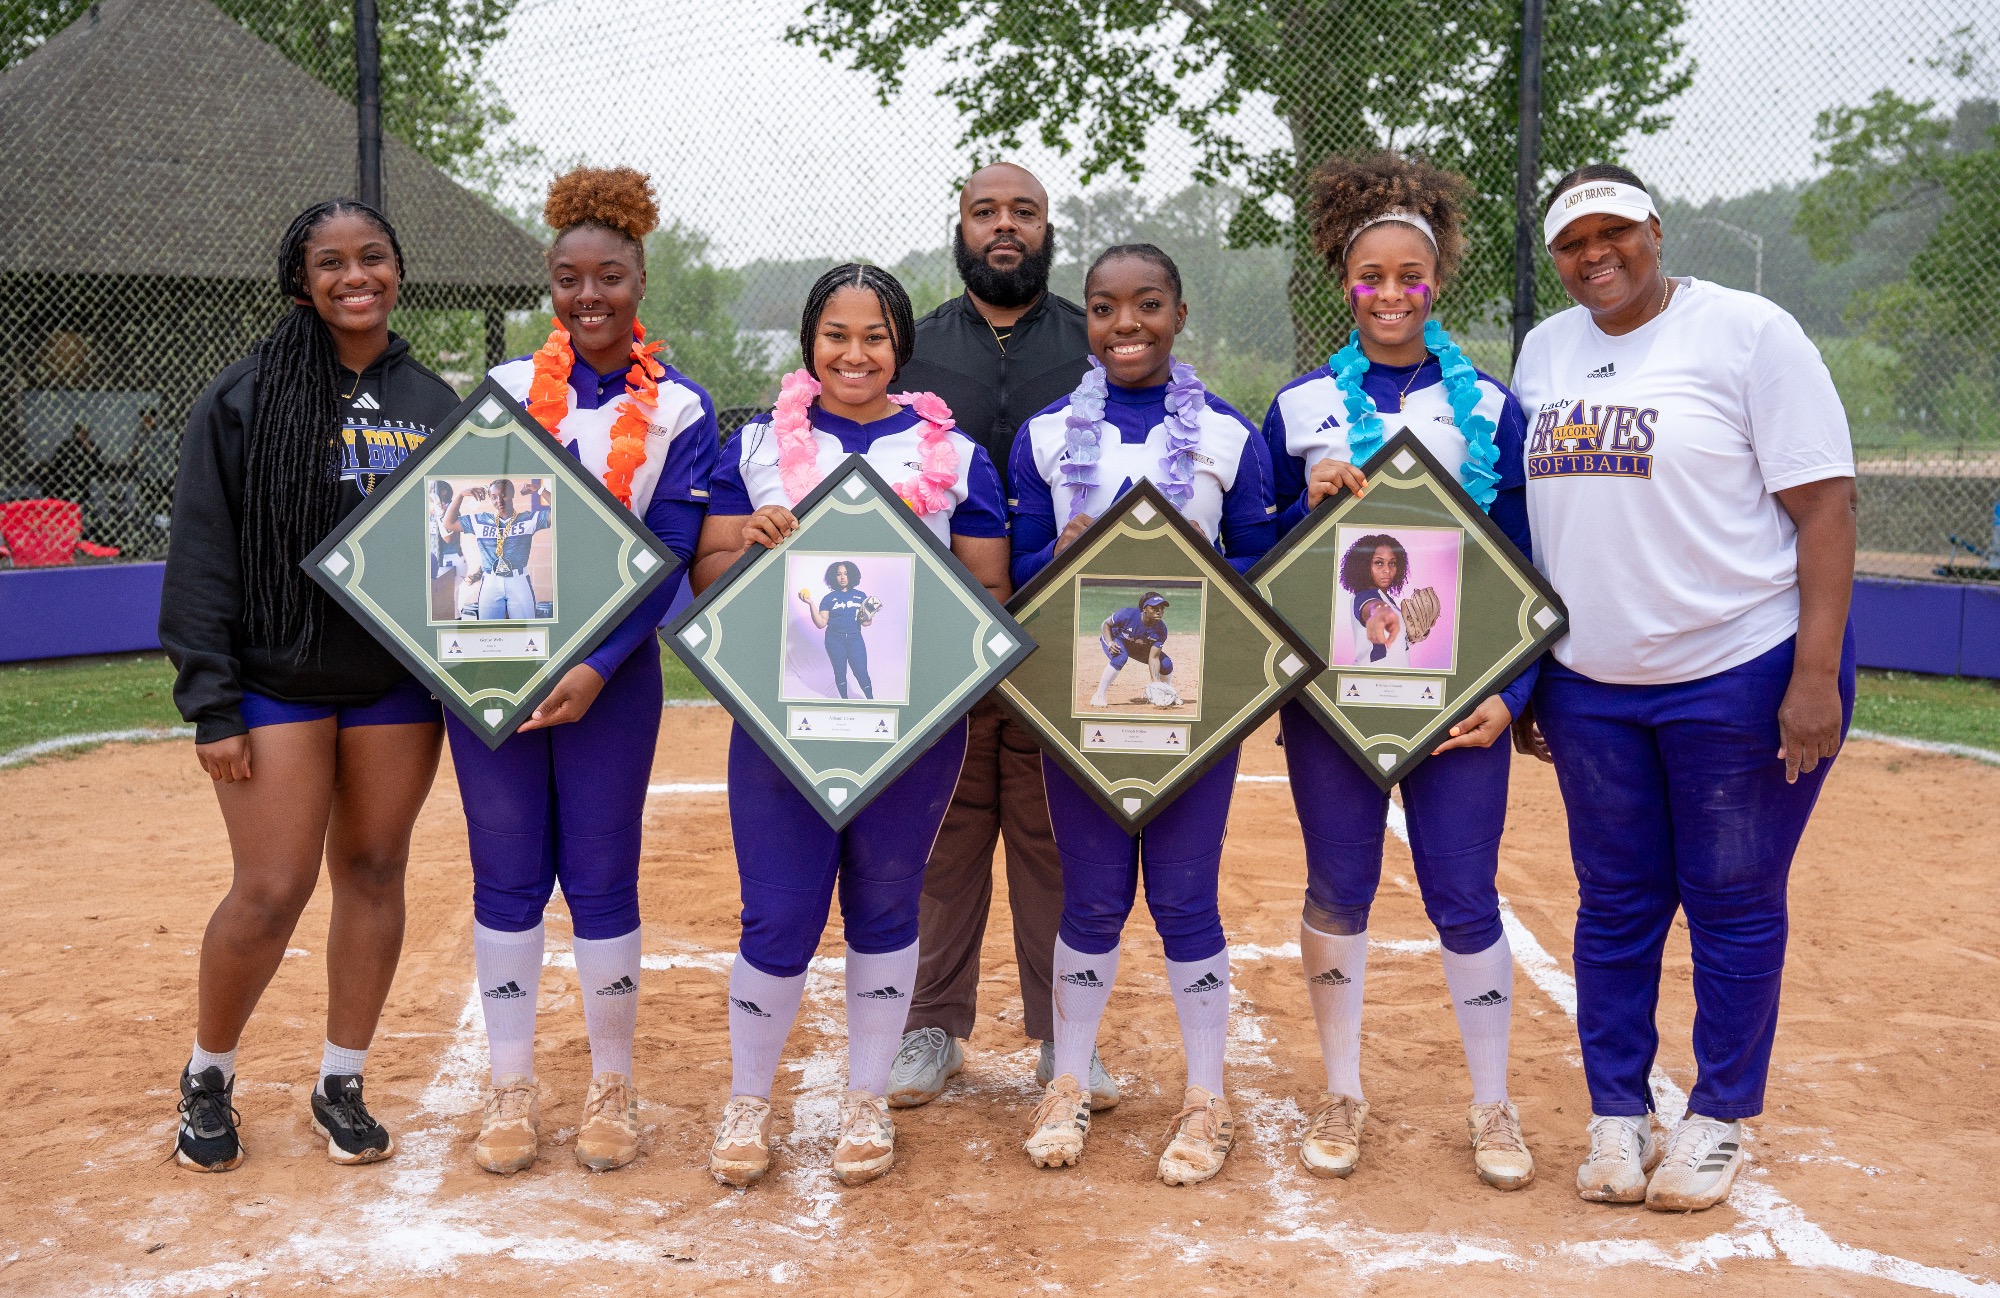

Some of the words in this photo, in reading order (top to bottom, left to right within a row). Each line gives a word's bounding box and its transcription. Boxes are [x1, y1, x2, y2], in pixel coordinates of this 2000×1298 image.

[1565, 191, 1584, 209] LADY
[1585, 187, 1616, 200] BRAVES
[1587, 371, 1616, 379] adidas
[1540, 399, 1574, 411] Lady
[1528, 399, 1659, 454] BRAVES
[1554, 426, 1597, 438] ALCORN
[1530, 455, 1645, 476] SOFTBALL
[1060, 975, 1104, 987] adidas
[1184, 980, 1224, 993] adidas
[1311, 976, 1352, 986] adidas
[484, 990, 527, 999] adidas
[597, 984, 637, 996] adidas
[1464, 995, 1508, 1006] adidas
